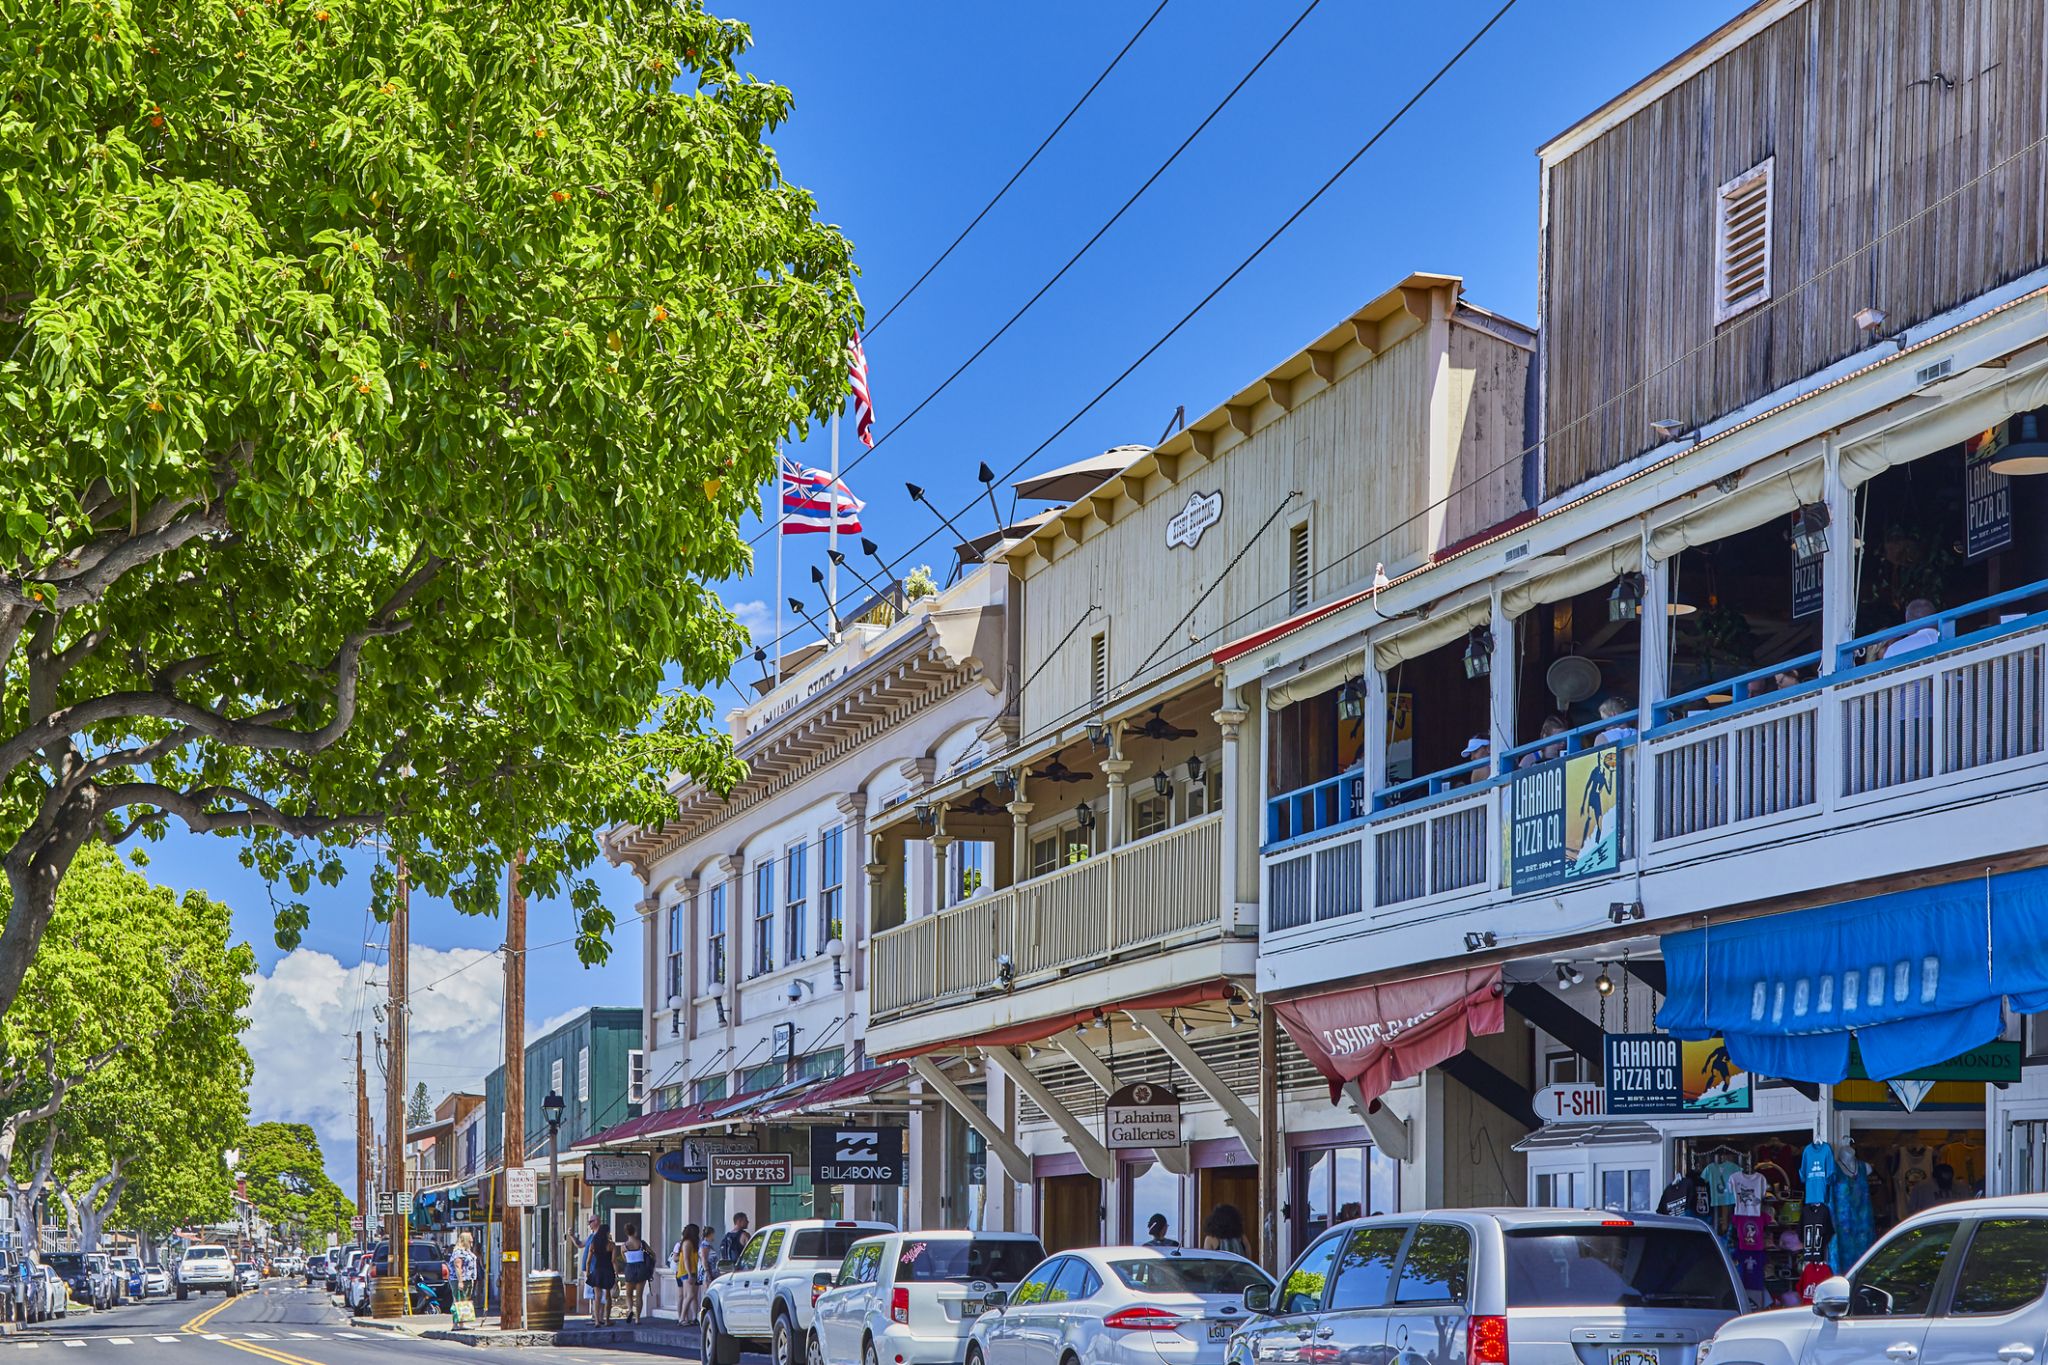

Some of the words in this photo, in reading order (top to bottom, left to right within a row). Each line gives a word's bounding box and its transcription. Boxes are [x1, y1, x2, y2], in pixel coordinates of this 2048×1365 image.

[1970, 495, 1994, 530] PIZZA
[1996, 490, 2009, 519] CO.
[1515, 767, 1562, 820] LAHAINA
[1515, 817, 1543, 859] PIZZA
[1547, 813, 1562, 850] CO.
[1613, 1040, 1677, 1067] LAHAINA
[1613, 1068, 1652, 1090] PIZZA
[1656, 1068, 1677, 1090] CO.
[1554, 1090, 1605, 1116] T-SHI
[1114, 1111, 1173, 1125] Lahaina
[1111, 1128, 1176, 1142] Galleries
[715, 1157, 746, 1167] Vintage
[747, 1157, 785, 1166] European
[821, 1166, 893, 1180] BILLABONG
[715, 1168, 786, 1180] POSTERS
